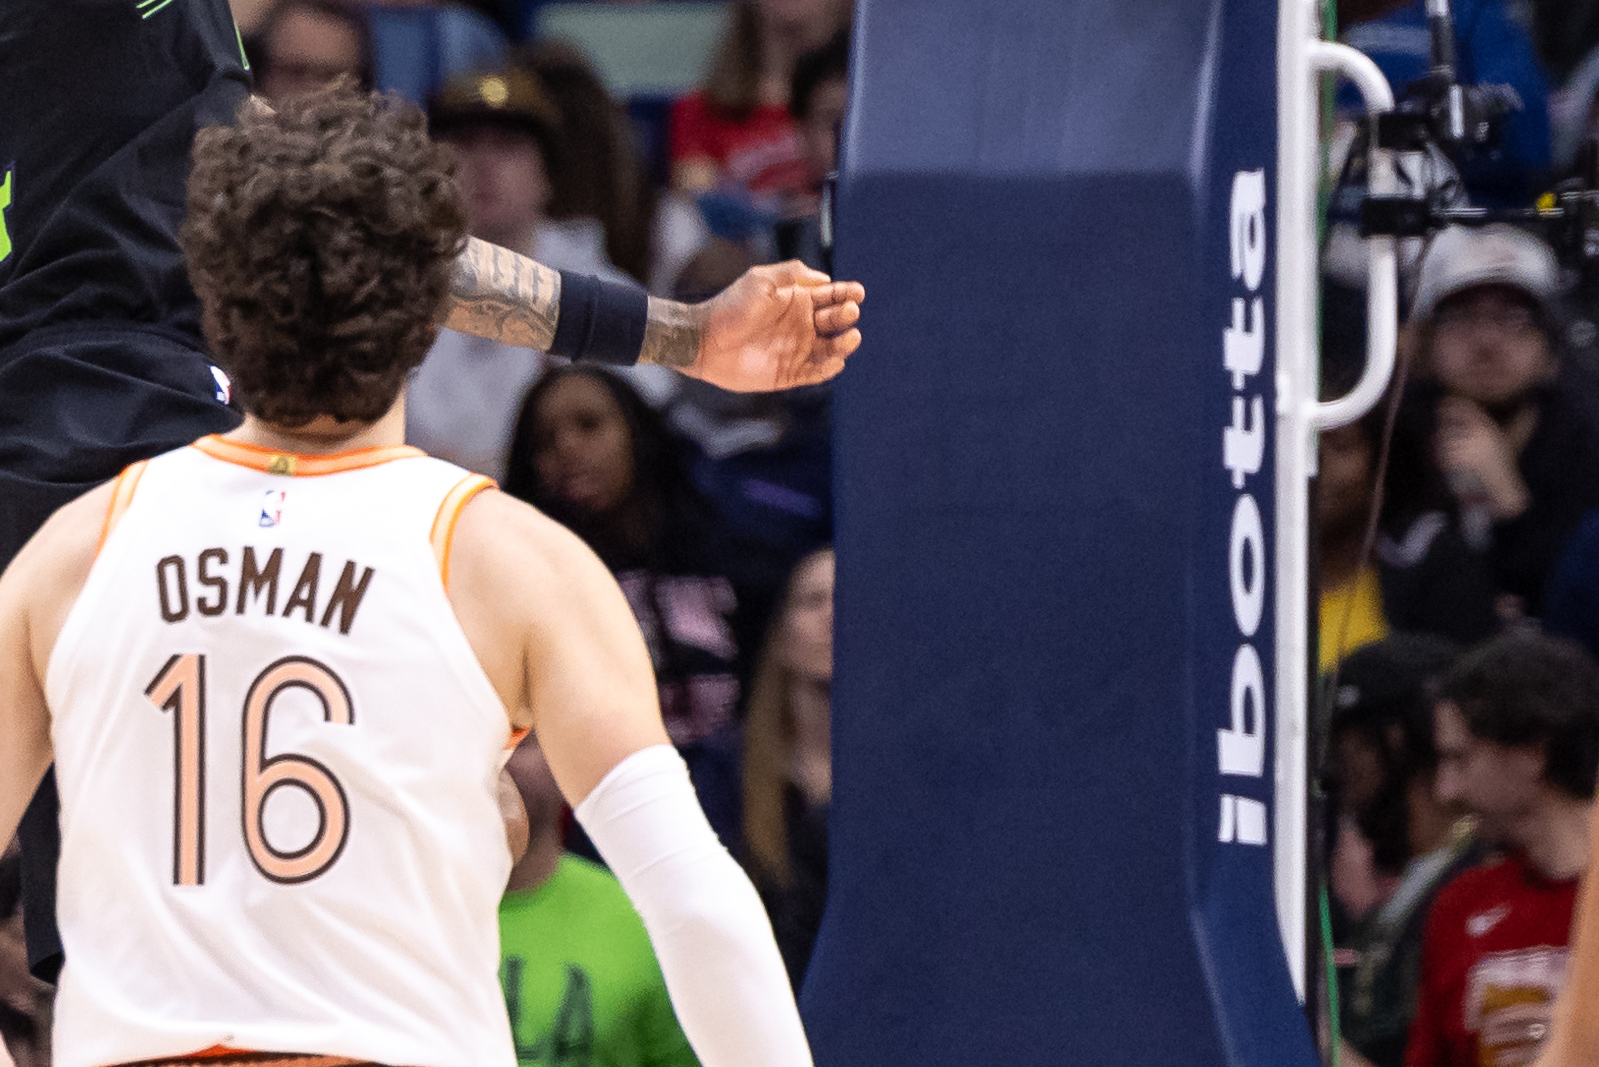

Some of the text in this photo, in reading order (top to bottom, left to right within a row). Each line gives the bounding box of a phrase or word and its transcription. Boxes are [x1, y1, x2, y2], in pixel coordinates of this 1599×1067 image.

[157, 545, 376, 636] OSMAN
[1217, 168, 1268, 846] ibotta
[144, 654, 355, 886] 16
